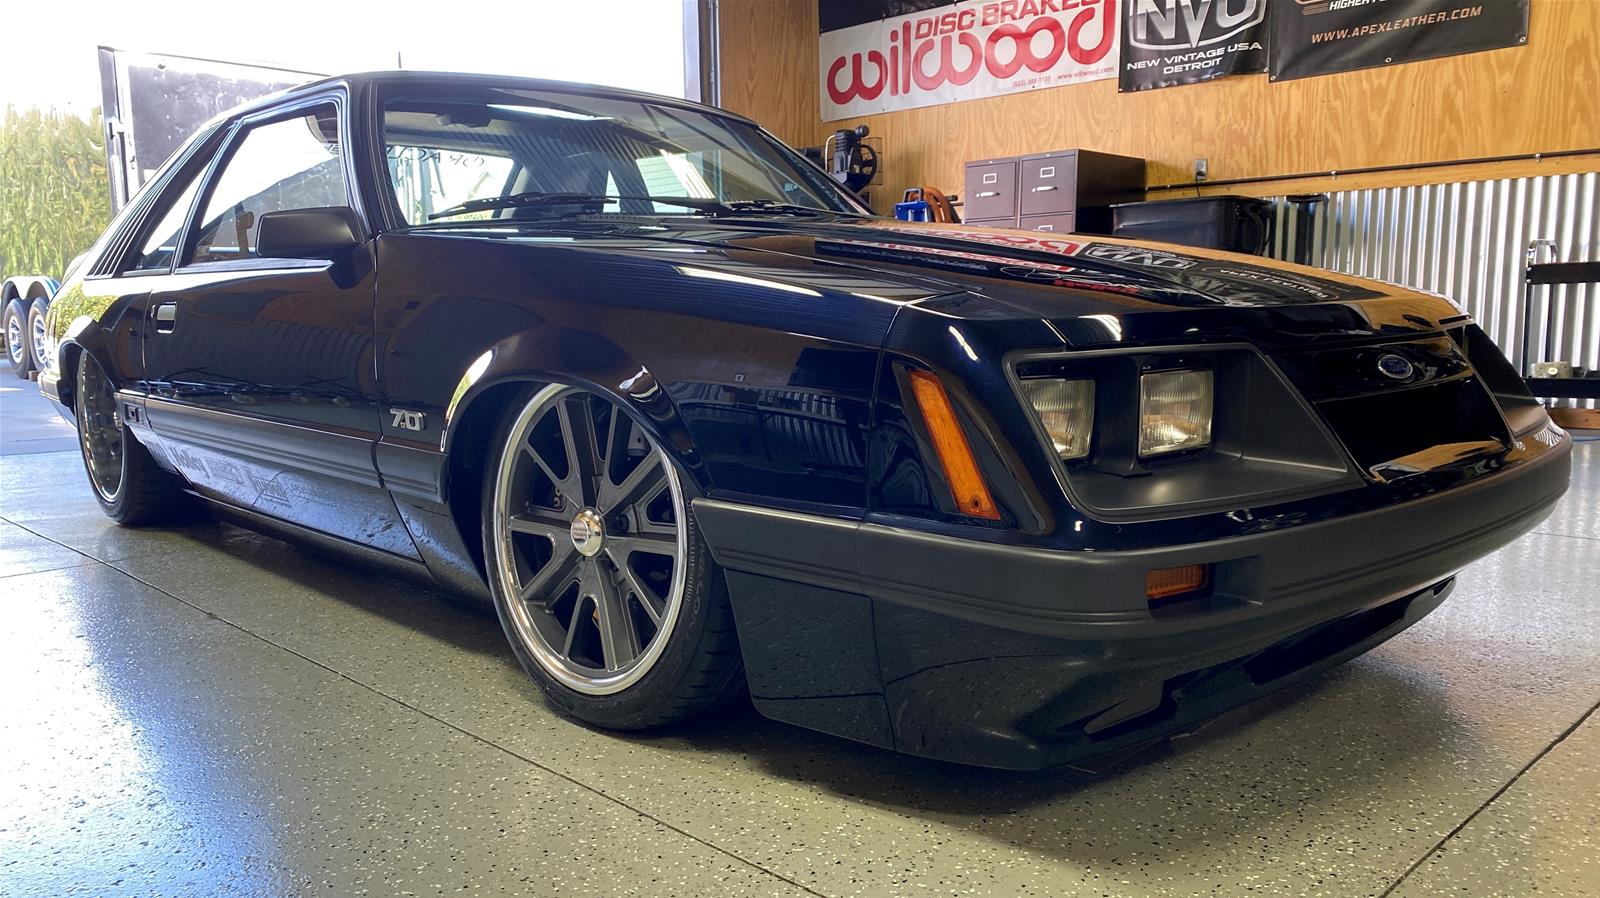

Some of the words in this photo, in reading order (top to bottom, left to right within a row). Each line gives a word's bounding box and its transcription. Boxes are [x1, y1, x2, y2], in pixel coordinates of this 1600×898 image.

[914, 8, 976, 40] DISC
[1311, 5, 1483, 44] WWW.APEXLEATHER.COM
[826, 0, 1115, 105] wilwood
[1126, 58, 1161, 71] NEW
[1164, 47, 1225, 64] VINTAGE
[1227, 41, 1263, 53] USA
[1163, 57, 1223, 75] DETROIT
